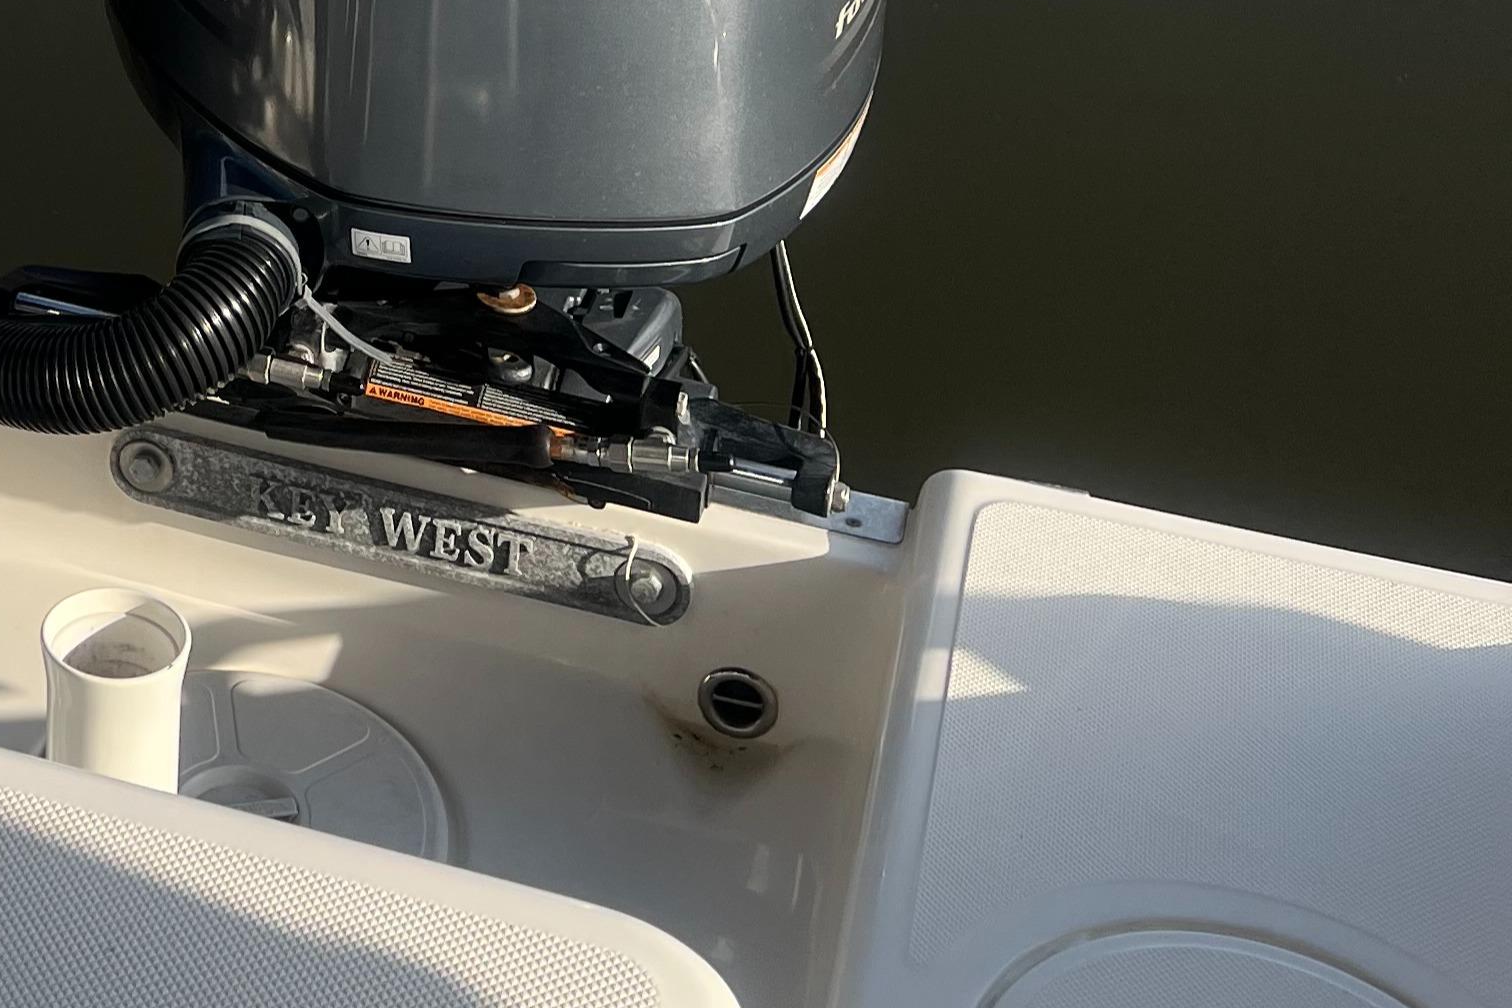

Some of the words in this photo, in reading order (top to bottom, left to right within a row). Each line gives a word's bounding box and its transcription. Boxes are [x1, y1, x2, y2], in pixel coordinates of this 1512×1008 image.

[379, 389, 425, 407] WARNING
[251, 479, 356, 535] KEY
[379, 507, 537, 577] WEST
